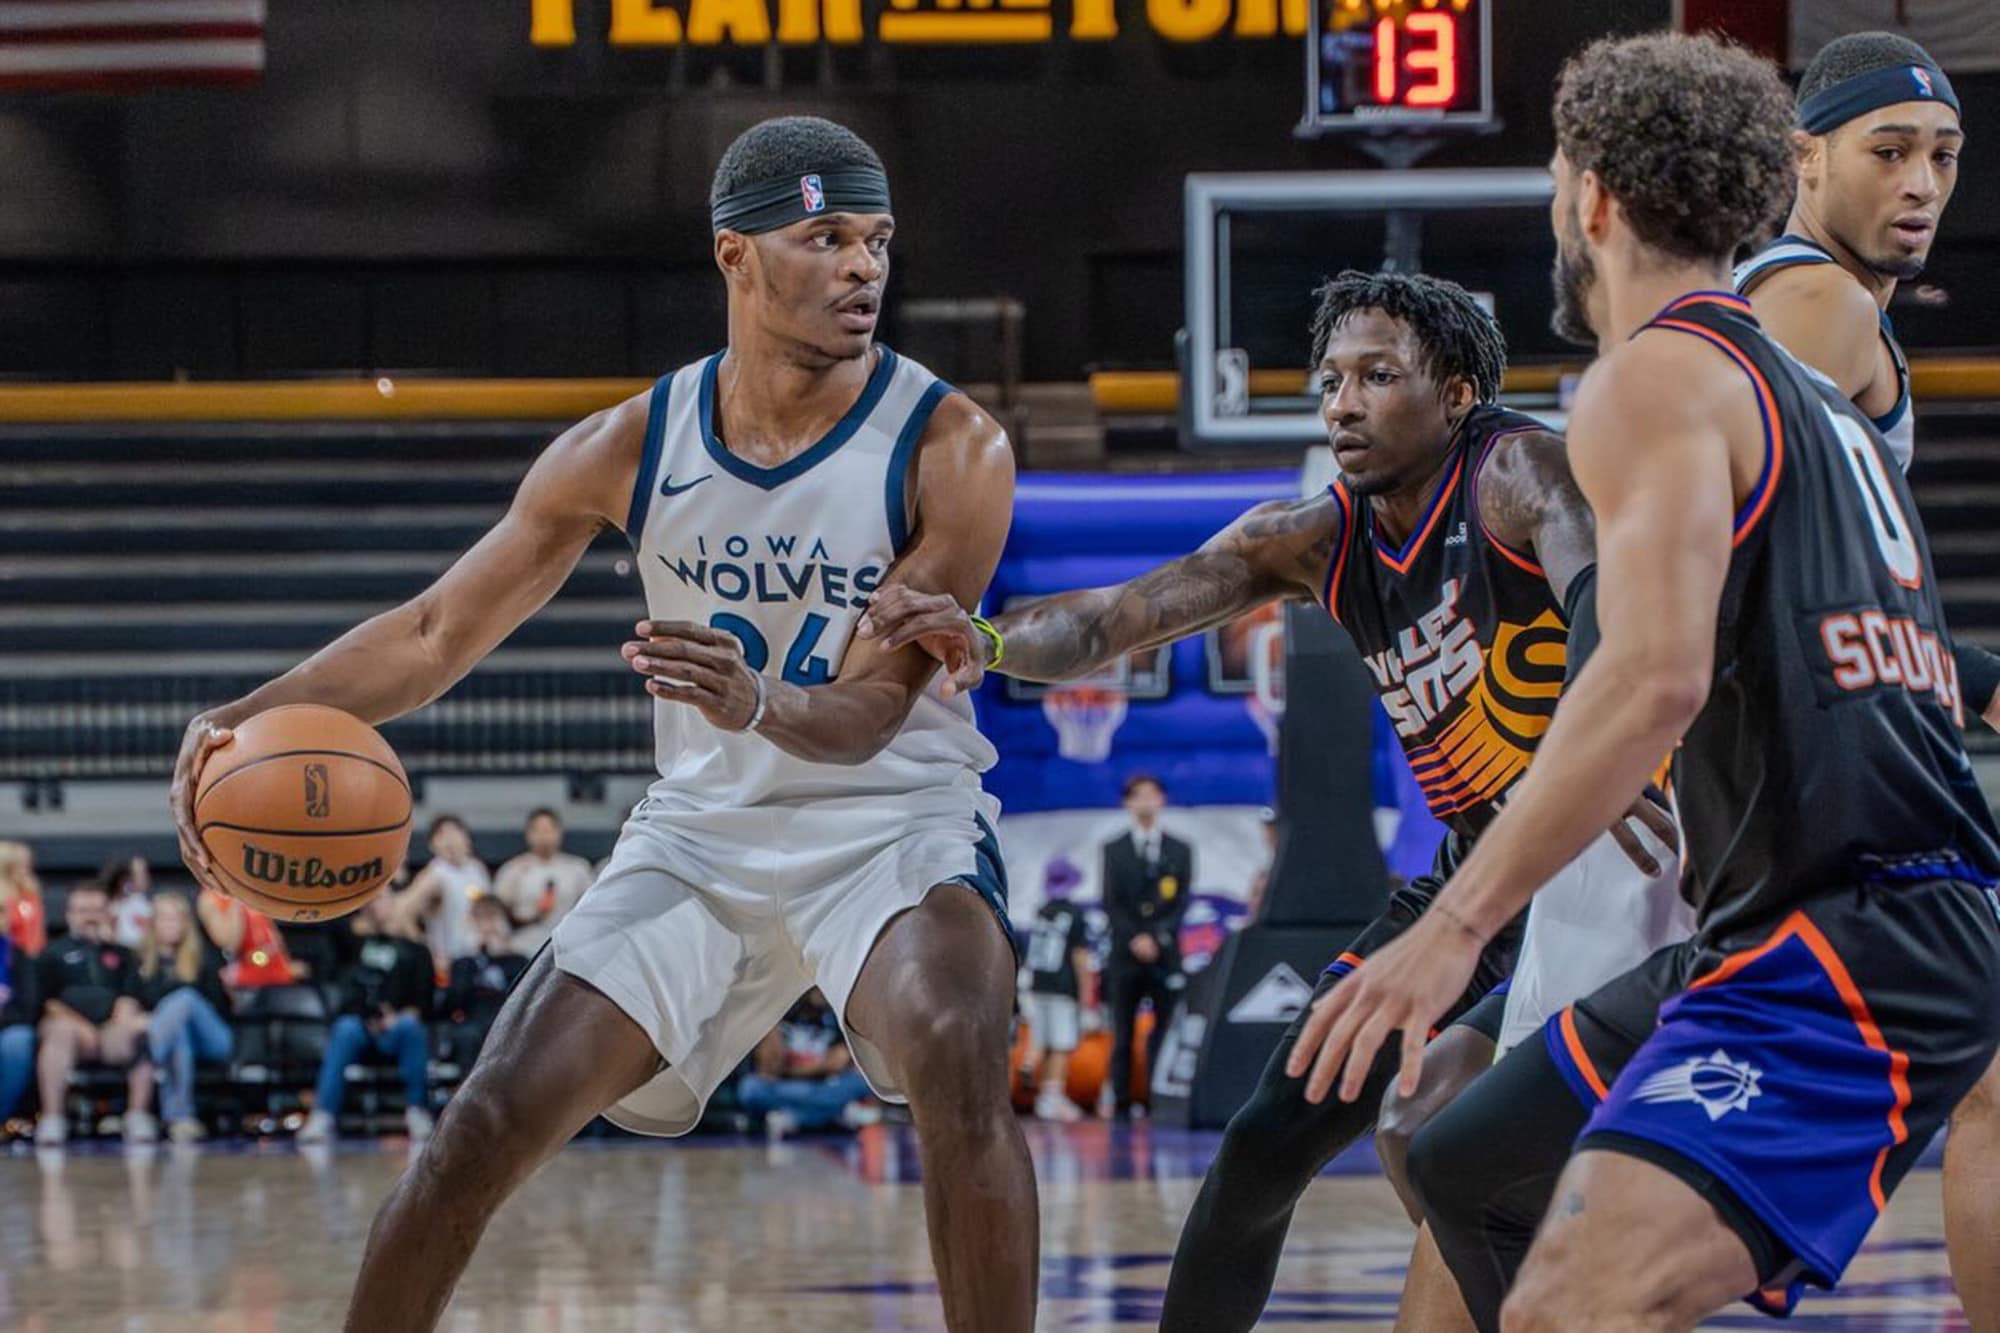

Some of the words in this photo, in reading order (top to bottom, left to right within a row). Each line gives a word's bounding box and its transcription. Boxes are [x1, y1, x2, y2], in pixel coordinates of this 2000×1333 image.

[1375, 11, 1456, 106] 13
[697, 535, 830, 561] IOWA
[657, 554, 880, 609] WOLVES
[242, 841, 386, 888] Wilson
